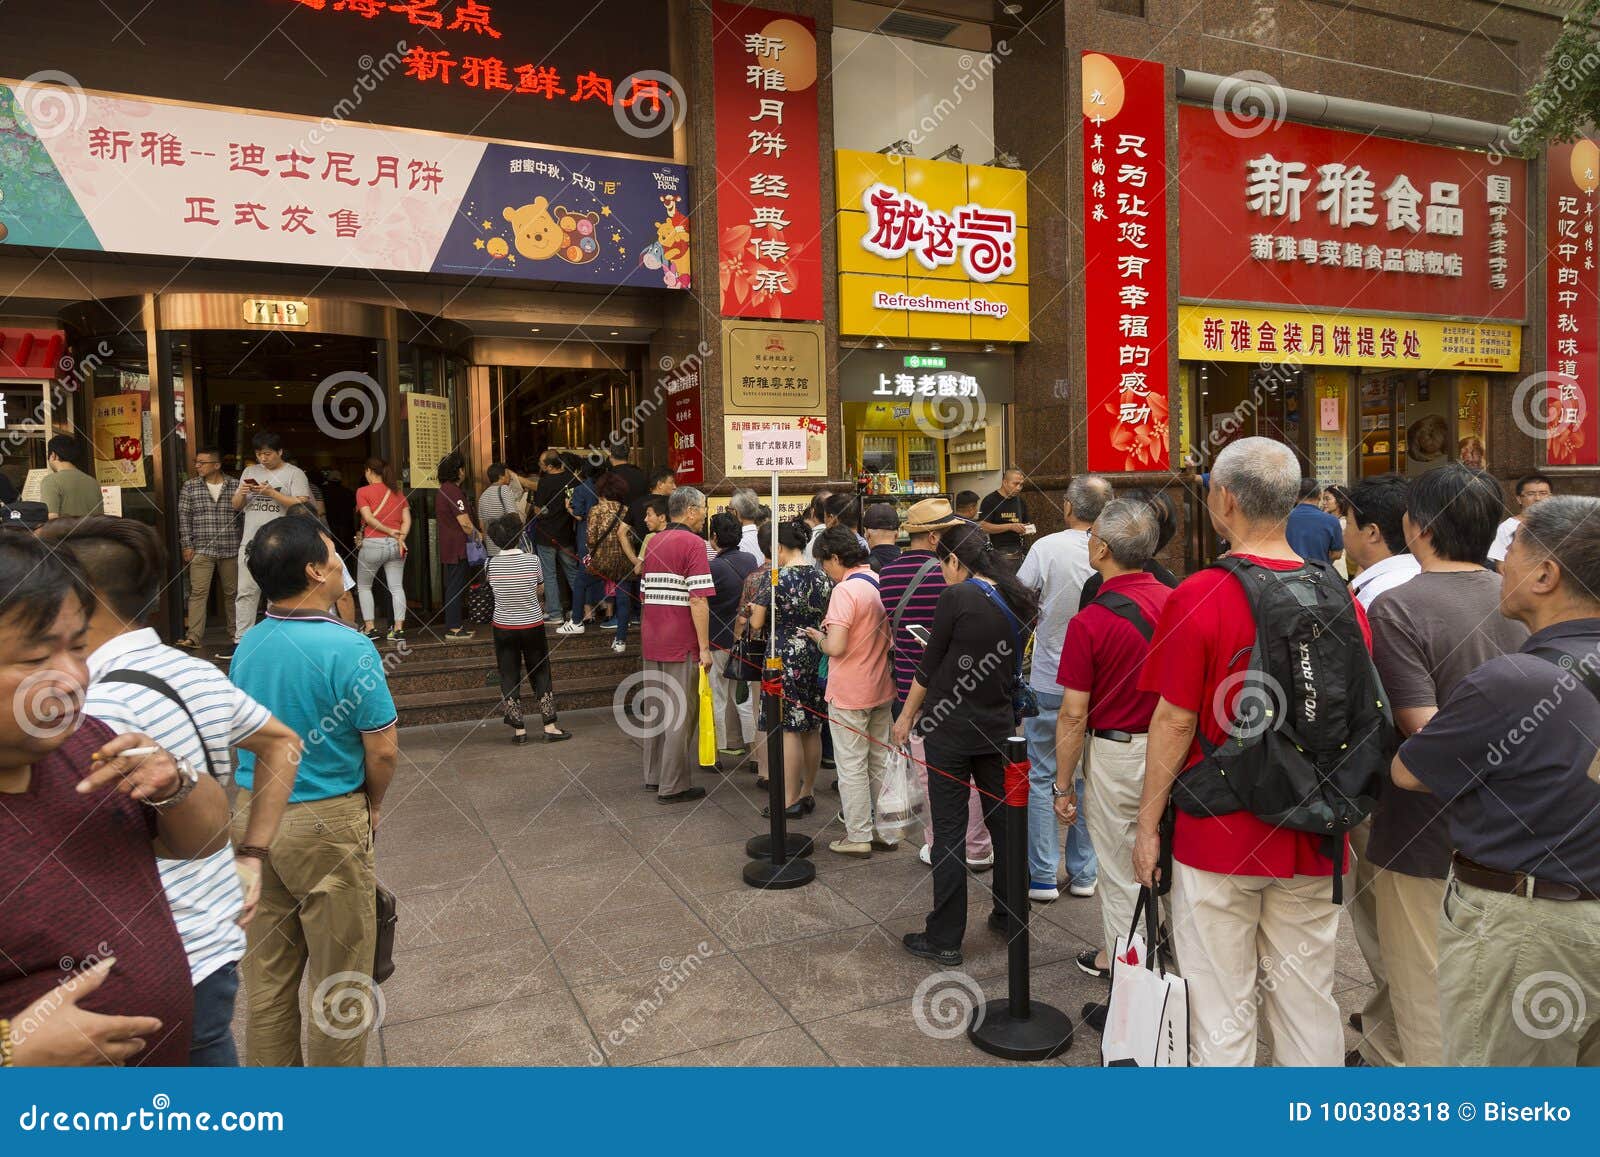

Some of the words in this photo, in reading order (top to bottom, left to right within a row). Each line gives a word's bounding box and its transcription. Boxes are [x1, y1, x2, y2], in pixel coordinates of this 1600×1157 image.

[288, 0, 502, 38] 海名点
[744, 33, 791, 294] 新雅月饼经典传承
[1090, 89, 1108, 222] 九十年的传承
[652, 172, 680, 183] Winnie
[657, 180, 676, 190] Pooh
[1245, 153, 1464, 236] 新雅食品
[184, 197, 362, 238] 正式发售
[1583, 168, 1595, 270] 九十年的传承
[1250, 232, 1464, 276] 新雅粤菜馆食品旗舰店
[1115, 134, 1150, 424] 只为让您有幸福的感动
[256, 302, 296, 314] 719
[878, 293, 970, 310] Refreshment
[974, 300, 1008, 315] Shop
[1558, 196, 1579, 426] 记忆中的中秋味道依旧
[1203, 317, 1421, 358] 新雅盒装月饼提货处
[873, 373, 978, 396] 上海老酸奶
[748, 440, 801, 450] 新雅广式散装月饼
[756, 457, 794, 466] 在此排队
[456, 500, 465, 511] 3
[1300, 641, 1314, 680] ROCK
[1305, 682, 1317, 722] WOLF
